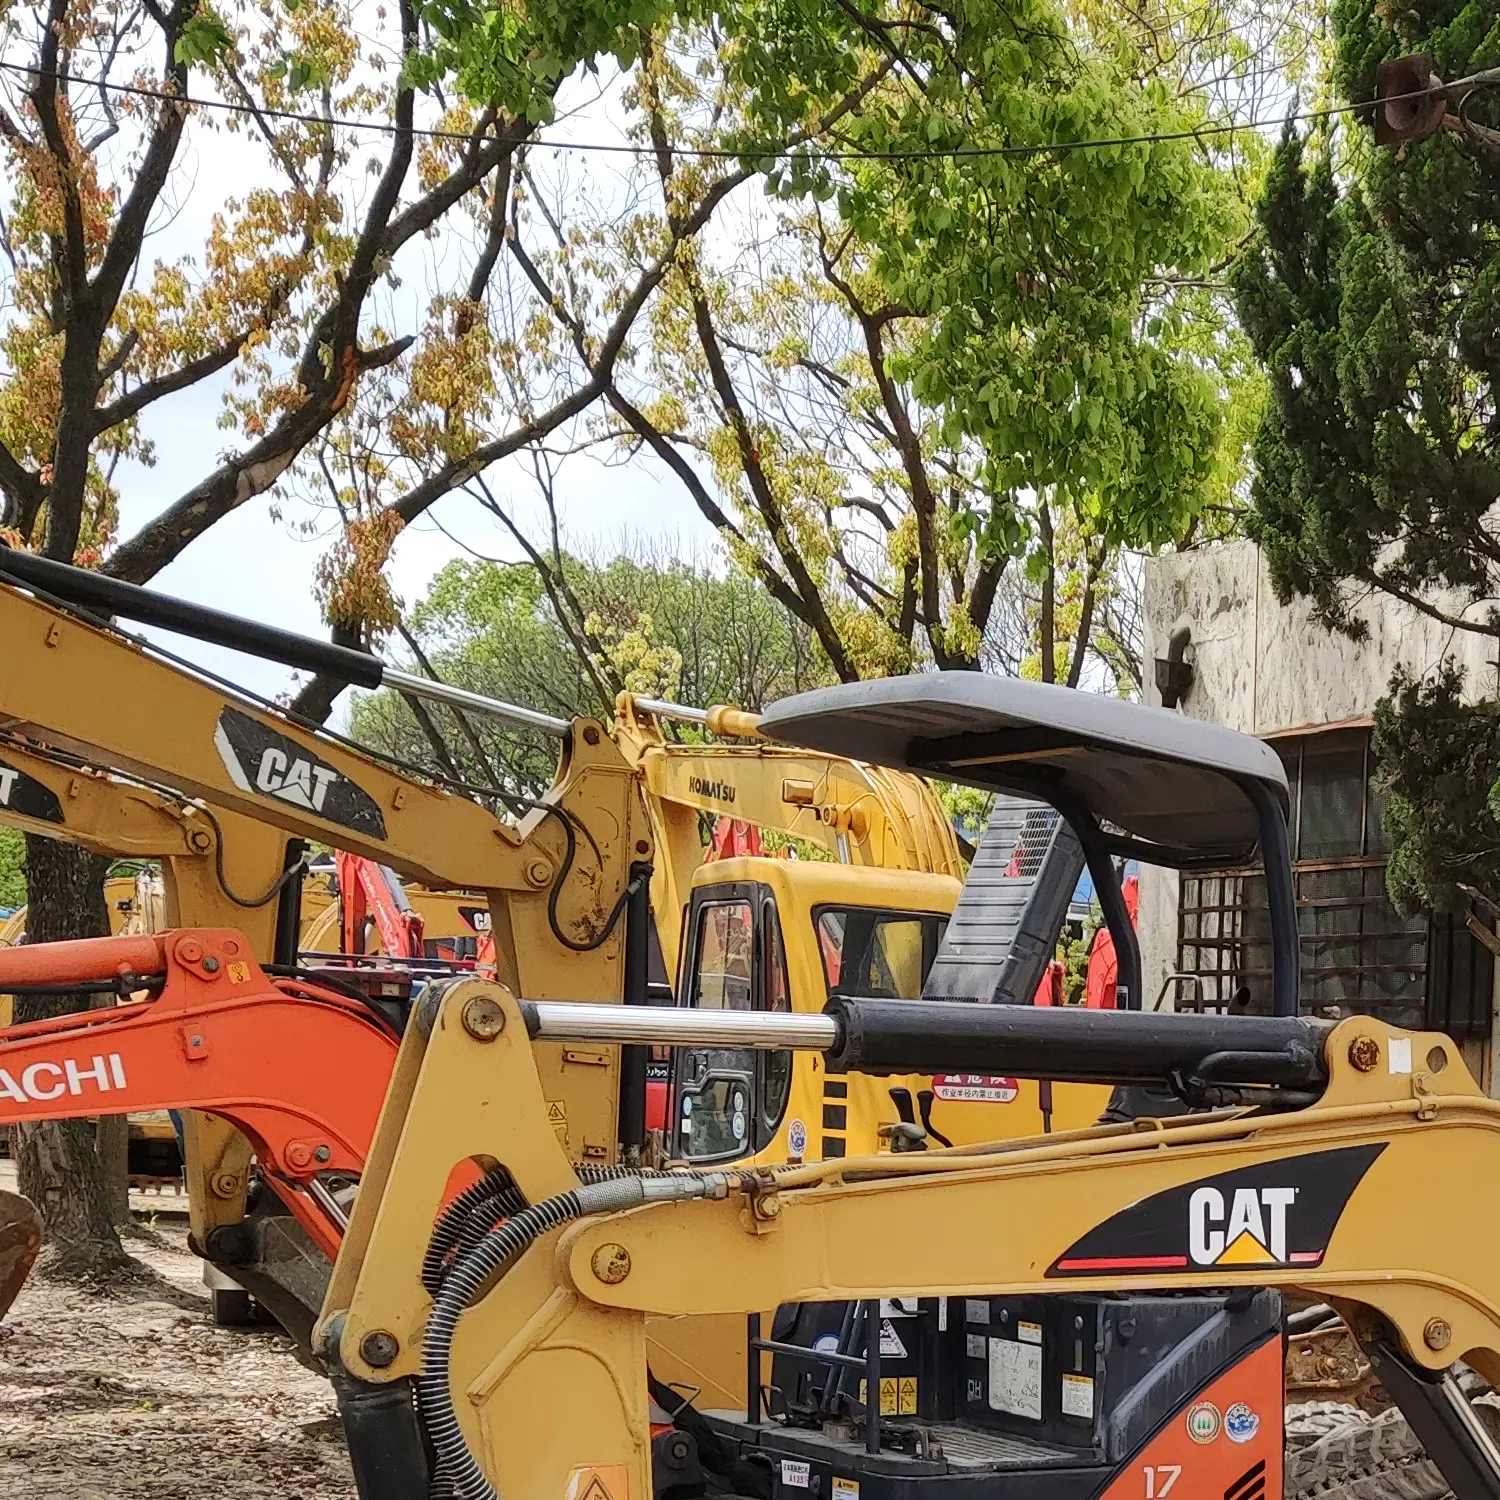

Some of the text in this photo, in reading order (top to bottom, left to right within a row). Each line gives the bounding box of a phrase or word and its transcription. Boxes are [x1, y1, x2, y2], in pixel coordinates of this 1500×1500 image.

[255, 748, 338, 812] CAT
[689, 776, 736, 803] KOMATSU
[473, 912, 492, 930] CA
[1189, 1187, 1295, 1265] CAT
[1143, 1465, 1182, 1499] 17
